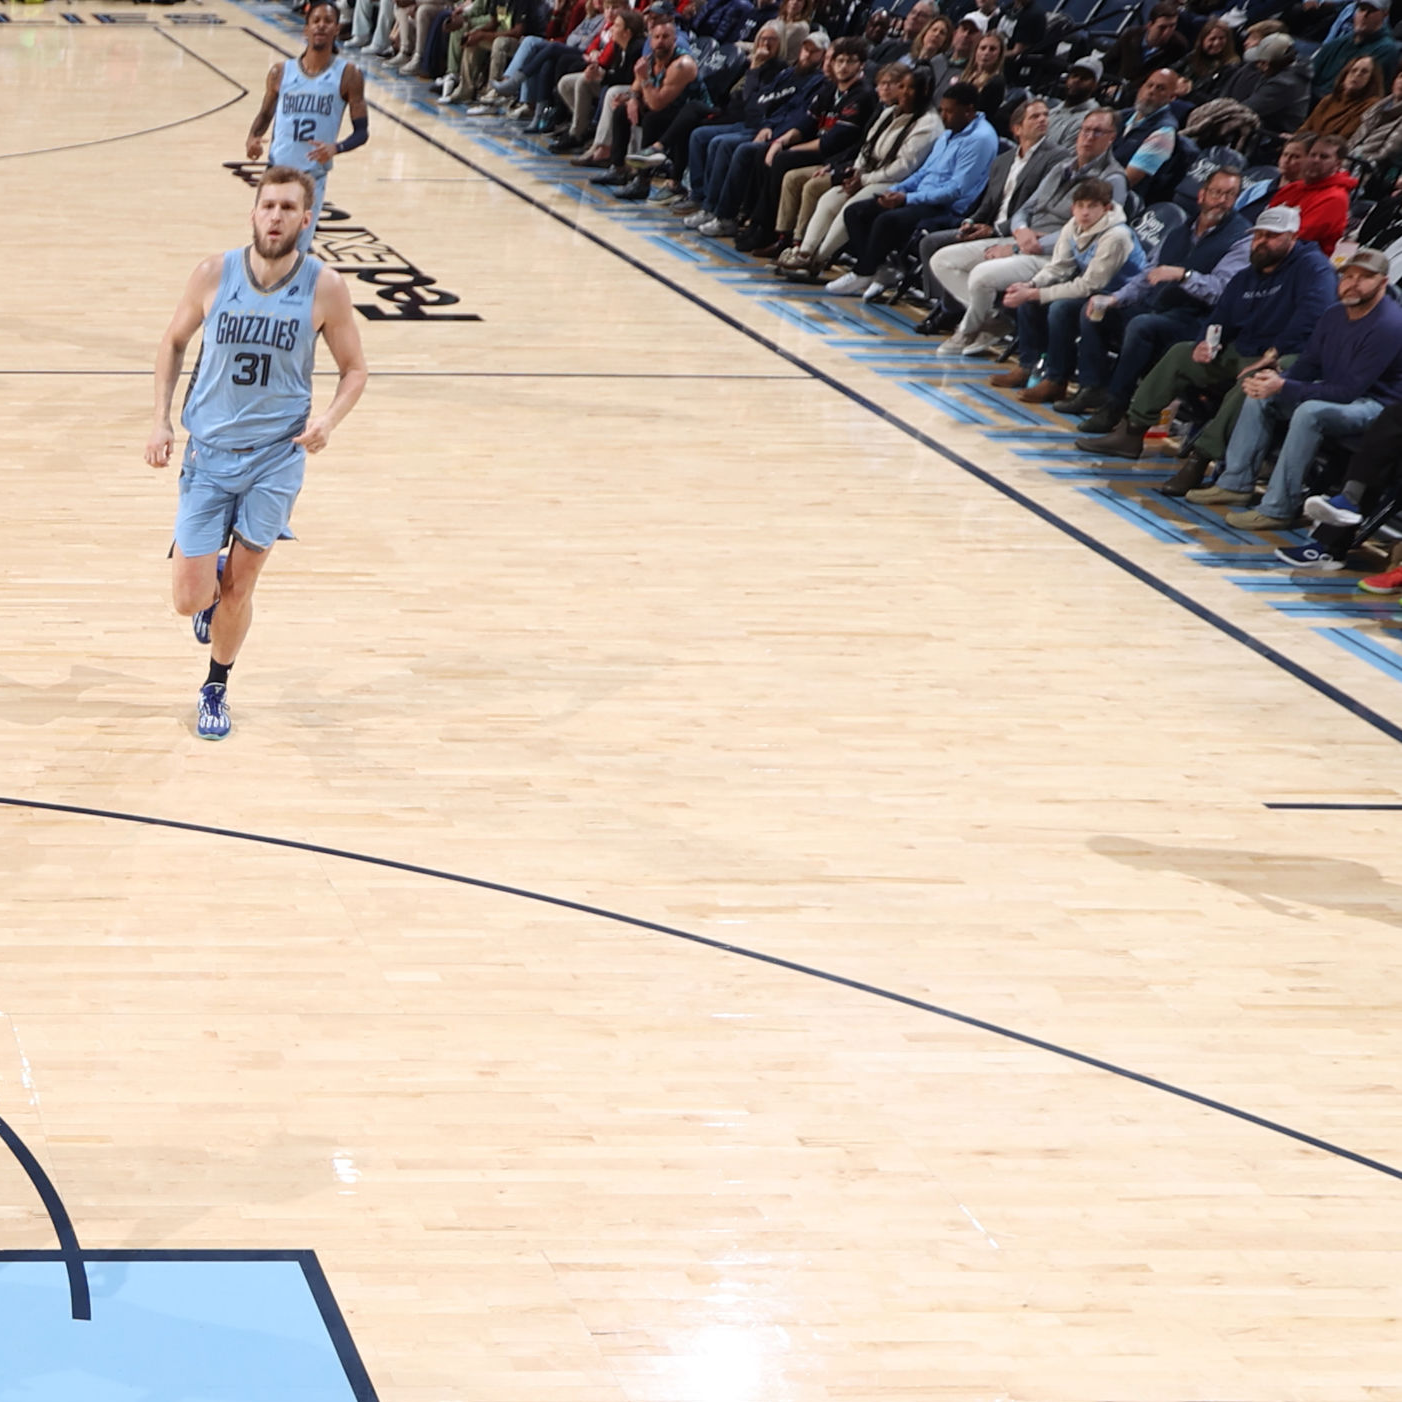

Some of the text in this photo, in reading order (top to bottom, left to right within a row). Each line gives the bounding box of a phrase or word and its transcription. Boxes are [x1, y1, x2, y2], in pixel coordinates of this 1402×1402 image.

[282, 93, 334, 116] GRIZZLIES
[292, 119, 317, 142] 12
[216, 311, 301, 352] GRIZZLIES
[232, 352, 272, 387] 31
